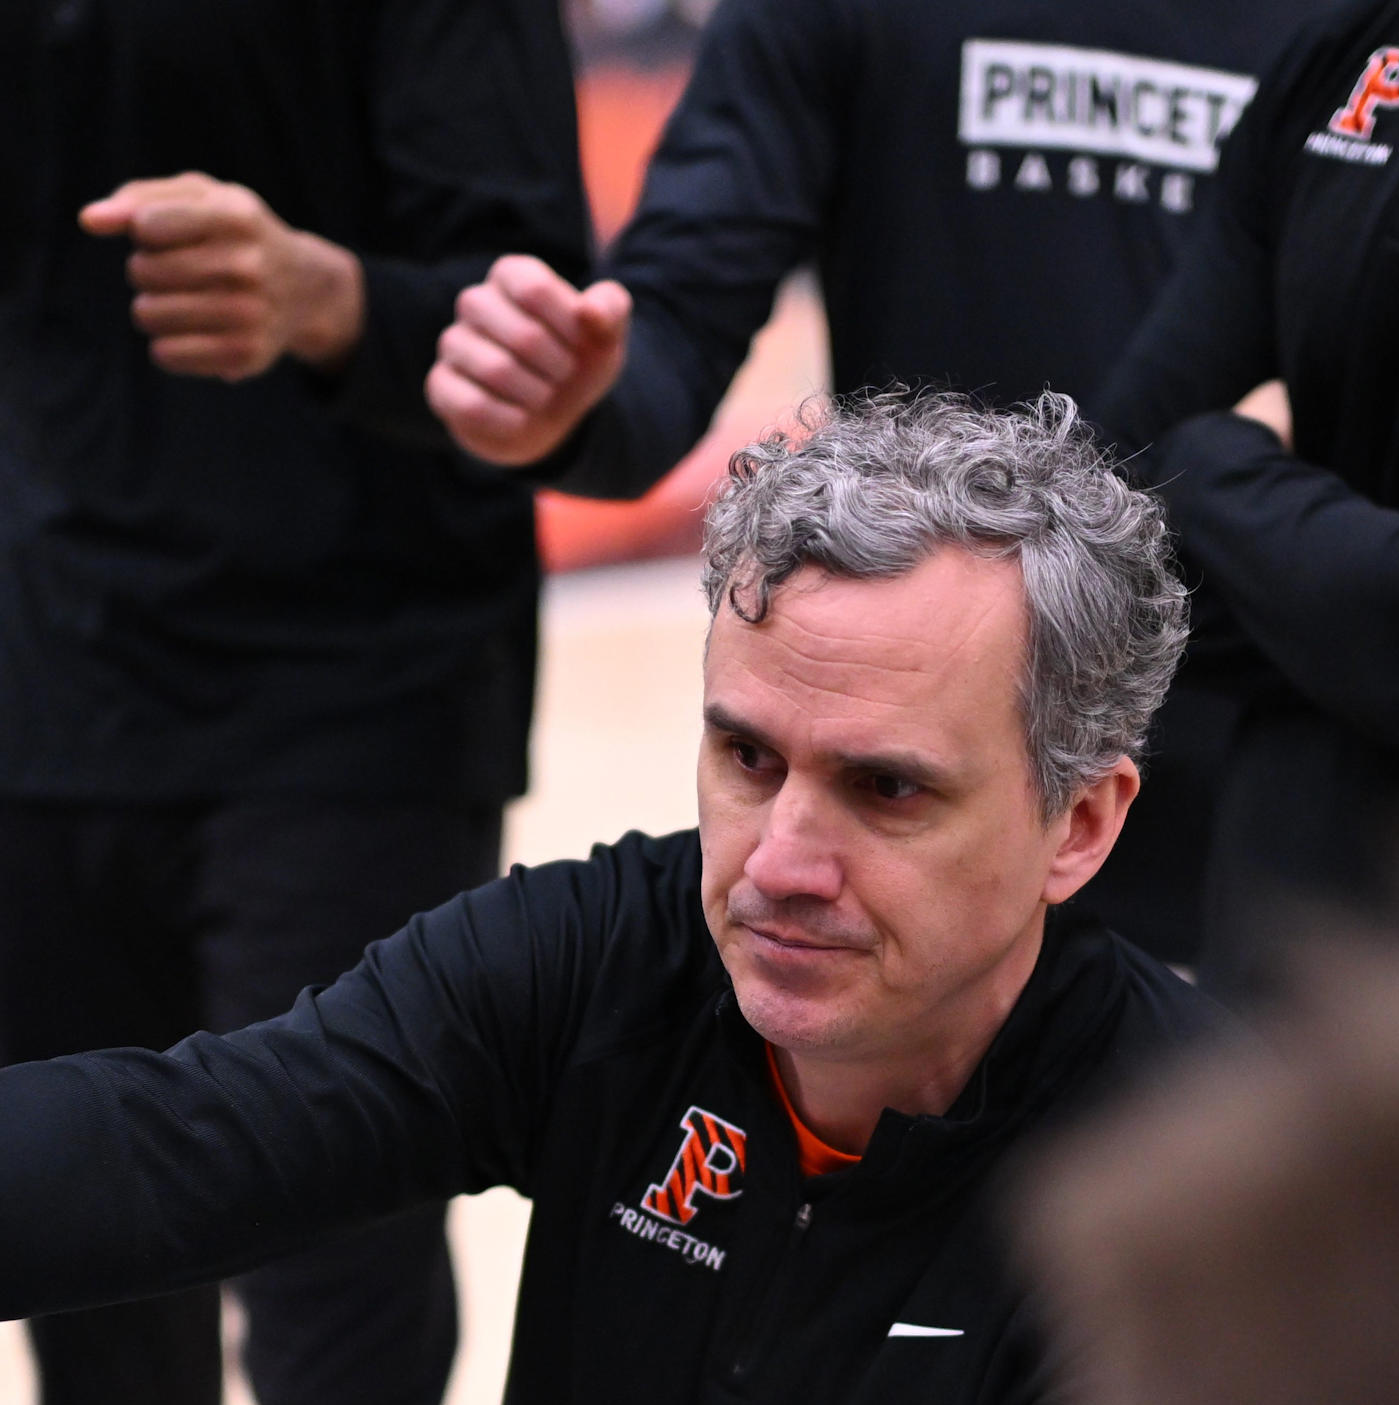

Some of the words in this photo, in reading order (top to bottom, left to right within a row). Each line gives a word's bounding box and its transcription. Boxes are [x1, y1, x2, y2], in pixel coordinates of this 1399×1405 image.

[981, 63, 1228, 146] PRINCET
[966, 151, 1195, 213] BASKE
[640, 1105, 748, 1226] P
[609, 1201, 726, 1271] PRINCETON
